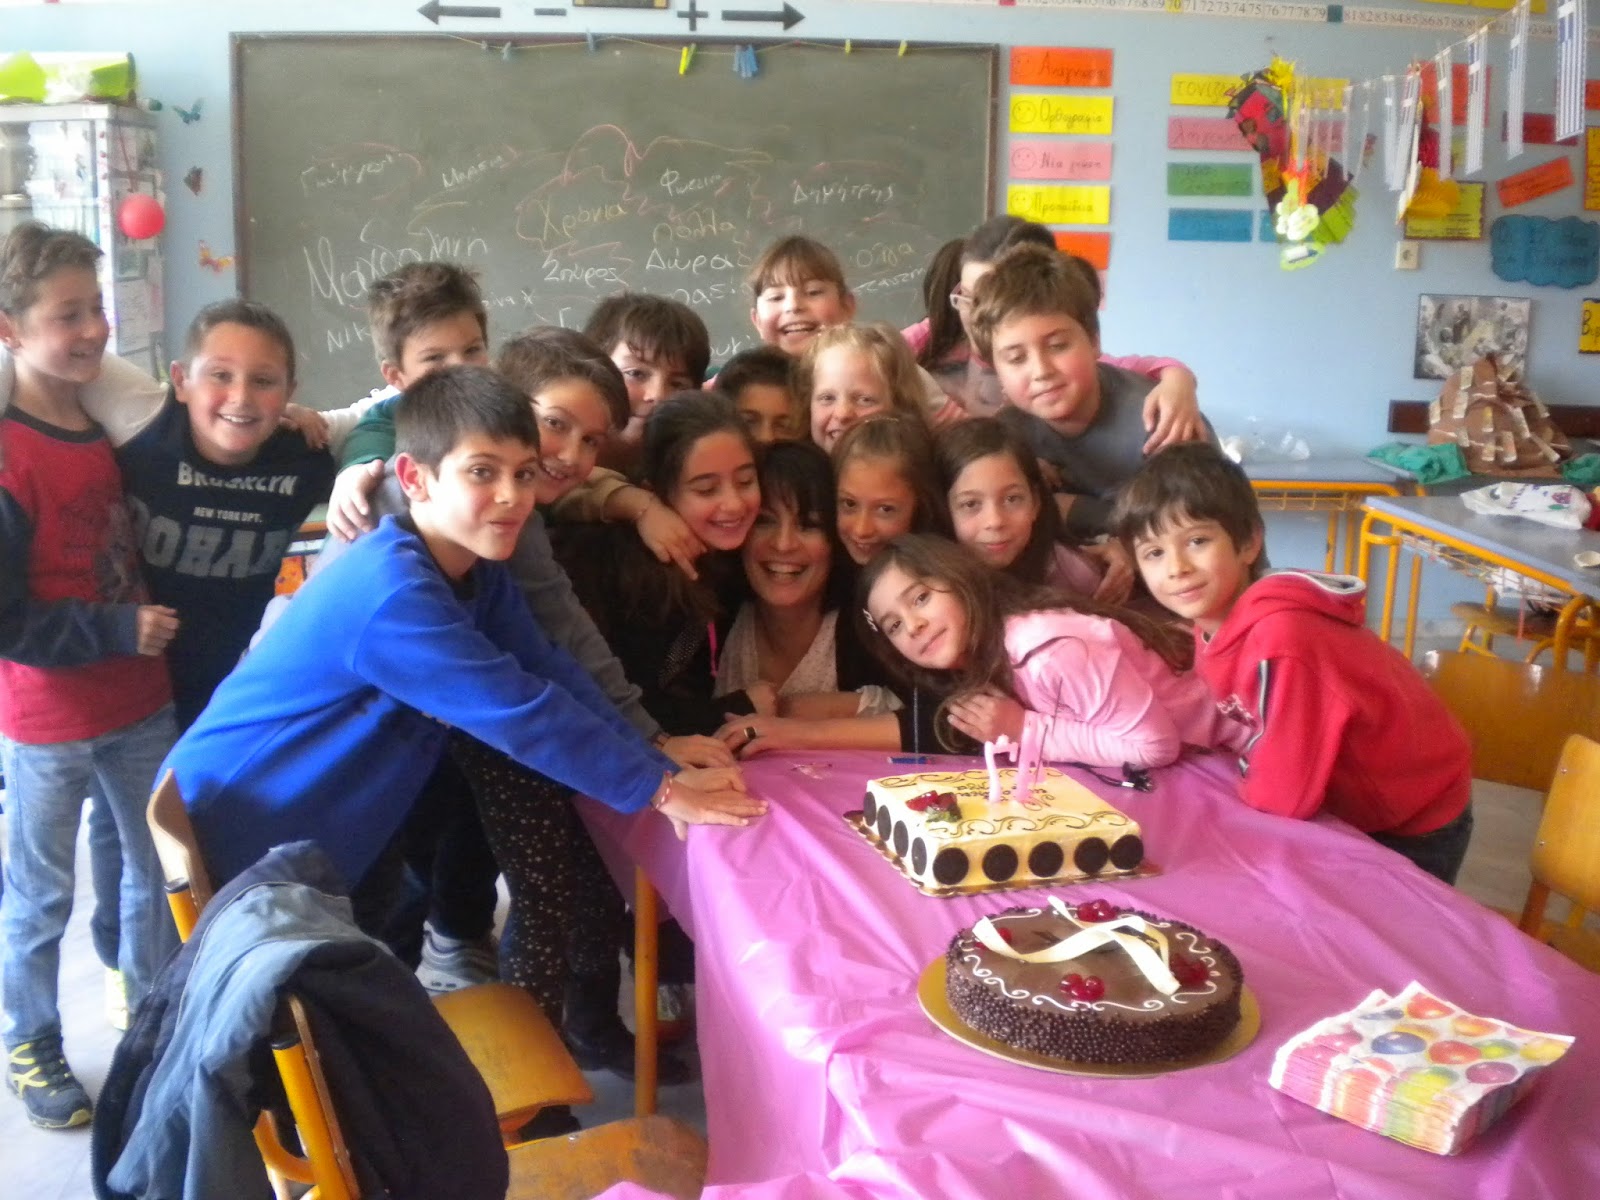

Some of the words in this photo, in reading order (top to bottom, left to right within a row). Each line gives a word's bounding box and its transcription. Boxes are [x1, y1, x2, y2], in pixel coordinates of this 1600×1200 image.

[1184, 0, 1196, 11] 71
[1200, 1, 1214, 12] 72
[1216, 2, 1230, 13] 73
[1232, 3, 1246, 14] 74
[1248, 3, 1262, 15] 75
[1265, 5, 1279, 16] 76
[1281, 6, 1295, 16] 77
[1297, 7, 1310, 18] 78
[1312, 8, 1326, 18] 79
[1359, 10, 1373, 21] 82
[1375, 11, 1388, 22] 83
[1406, 13, 1418, 23] 85
[1422, 15, 1435, 25] 86
[1436, 15, 1449, 26] 87
[1451, 16, 1464, 26] 88
[645, 247, 735, 275] Δώρα
[193, 506, 215, 518] NEW
[217, 508, 240, 522] YORK
